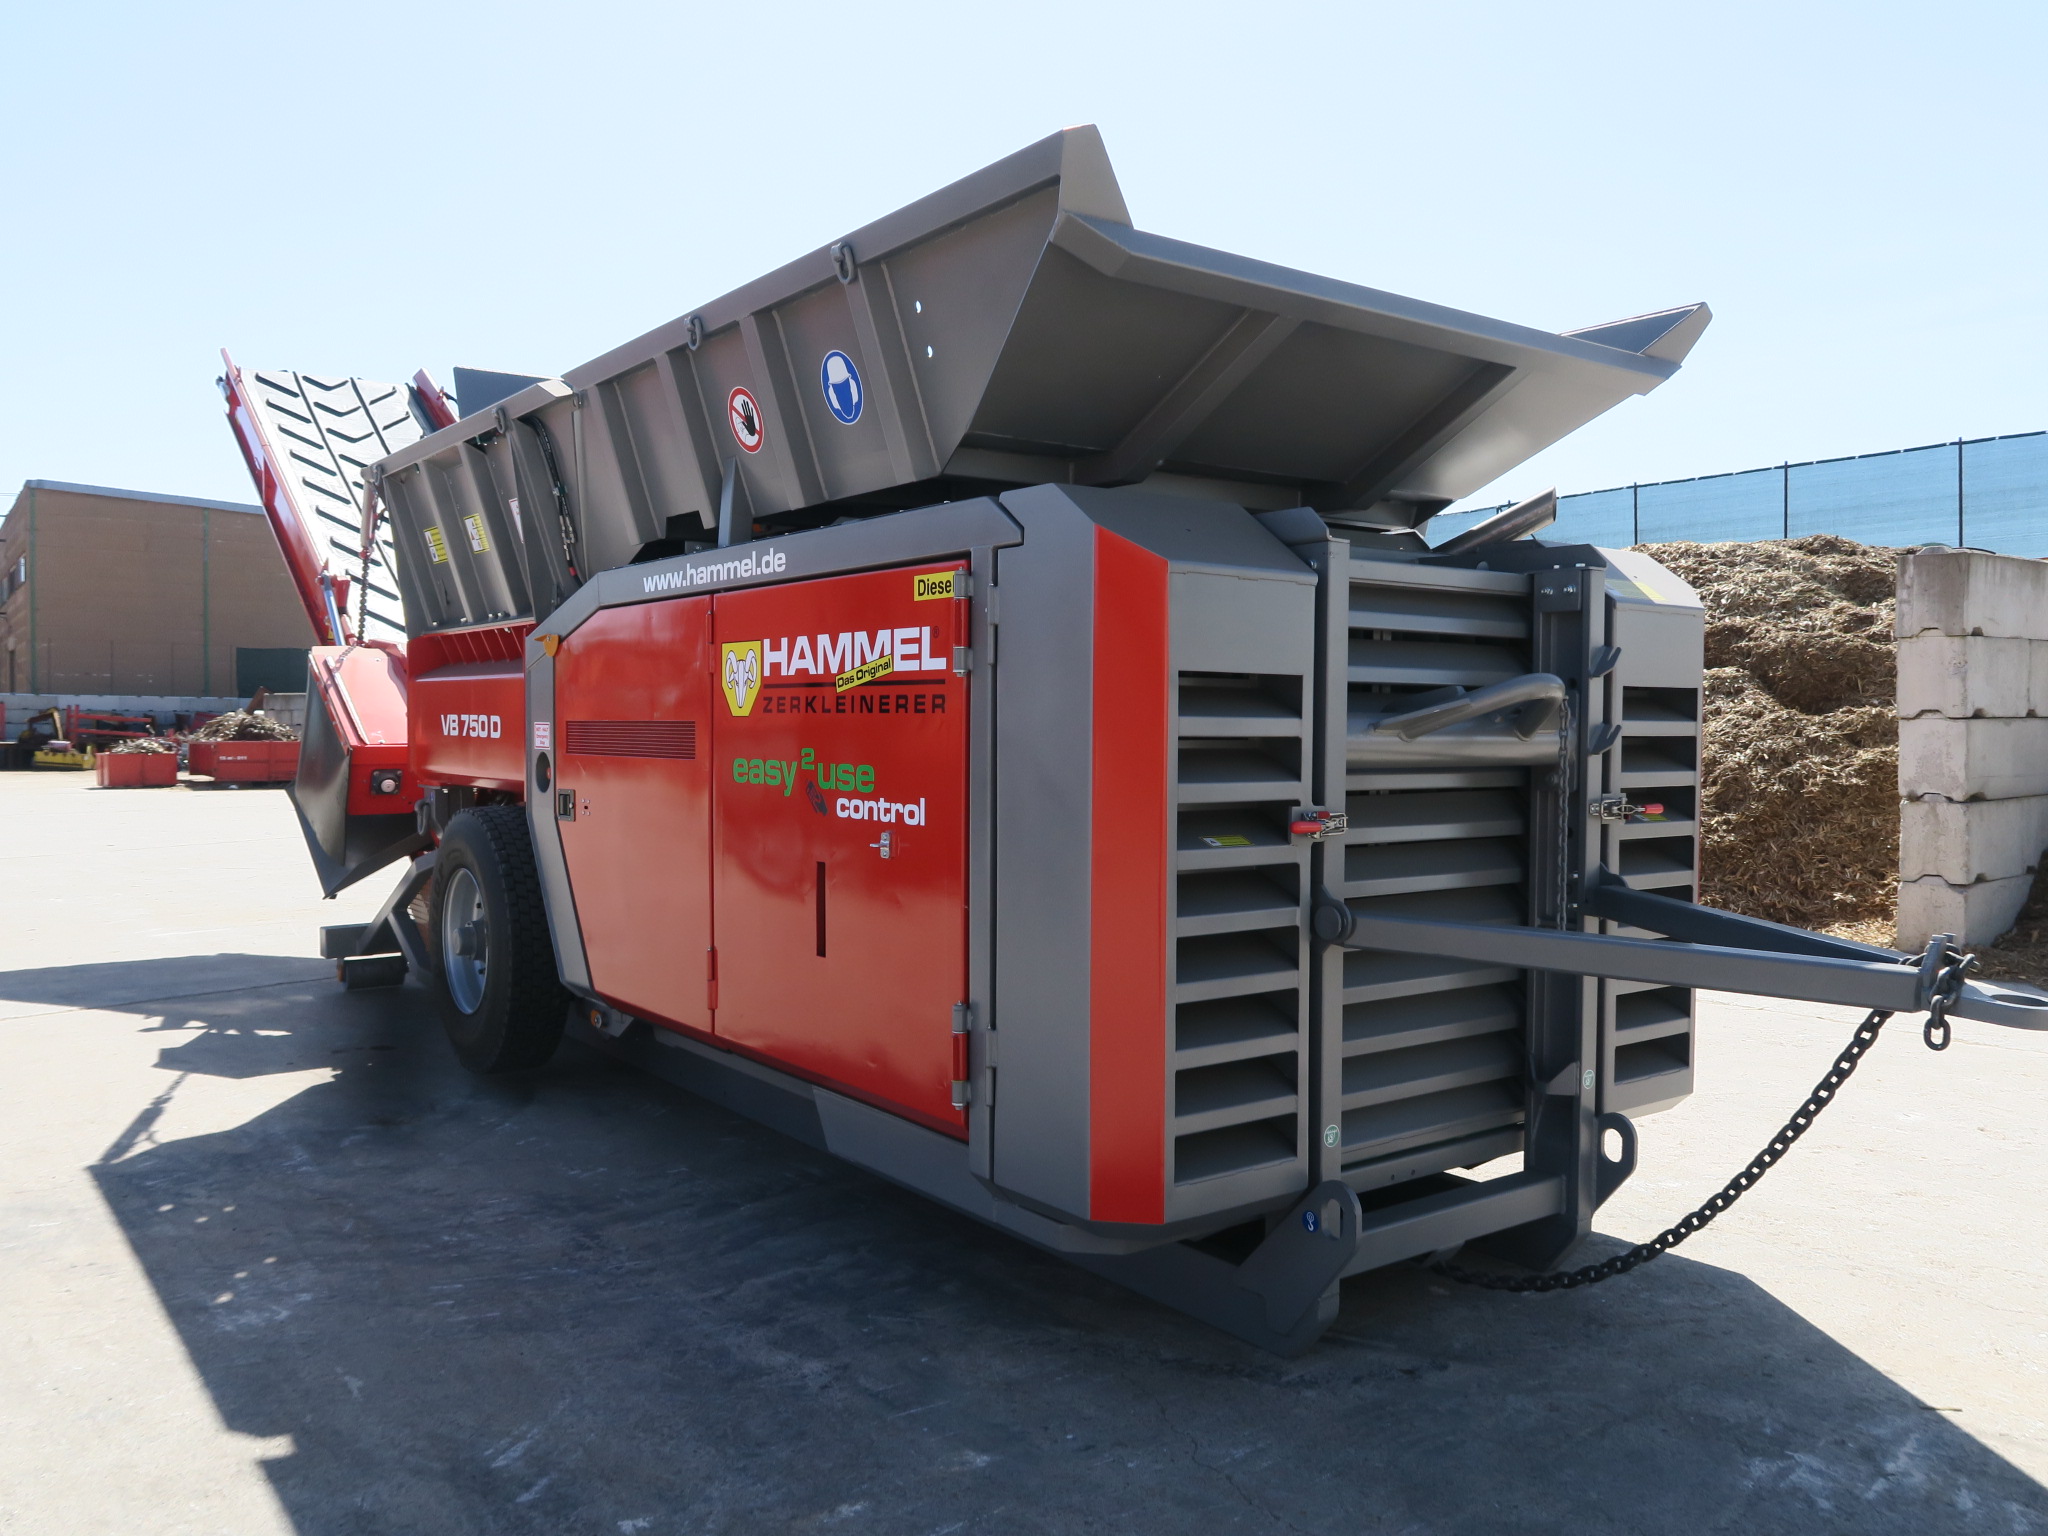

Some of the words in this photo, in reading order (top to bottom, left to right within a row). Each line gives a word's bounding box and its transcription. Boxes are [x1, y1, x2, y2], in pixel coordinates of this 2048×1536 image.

[643, 548, 786, 592] www.hammel.de
[837, 675, 855, 688] Das
[856, 658, 891, 680] Original
[762, 694, 946, 714] ZERKLEINERER
[440, 714, 459, 736] VB
[461, 714, 488, 738] 750
[490, 715, 501, 739] D
[836, 797, 926, 827] control
